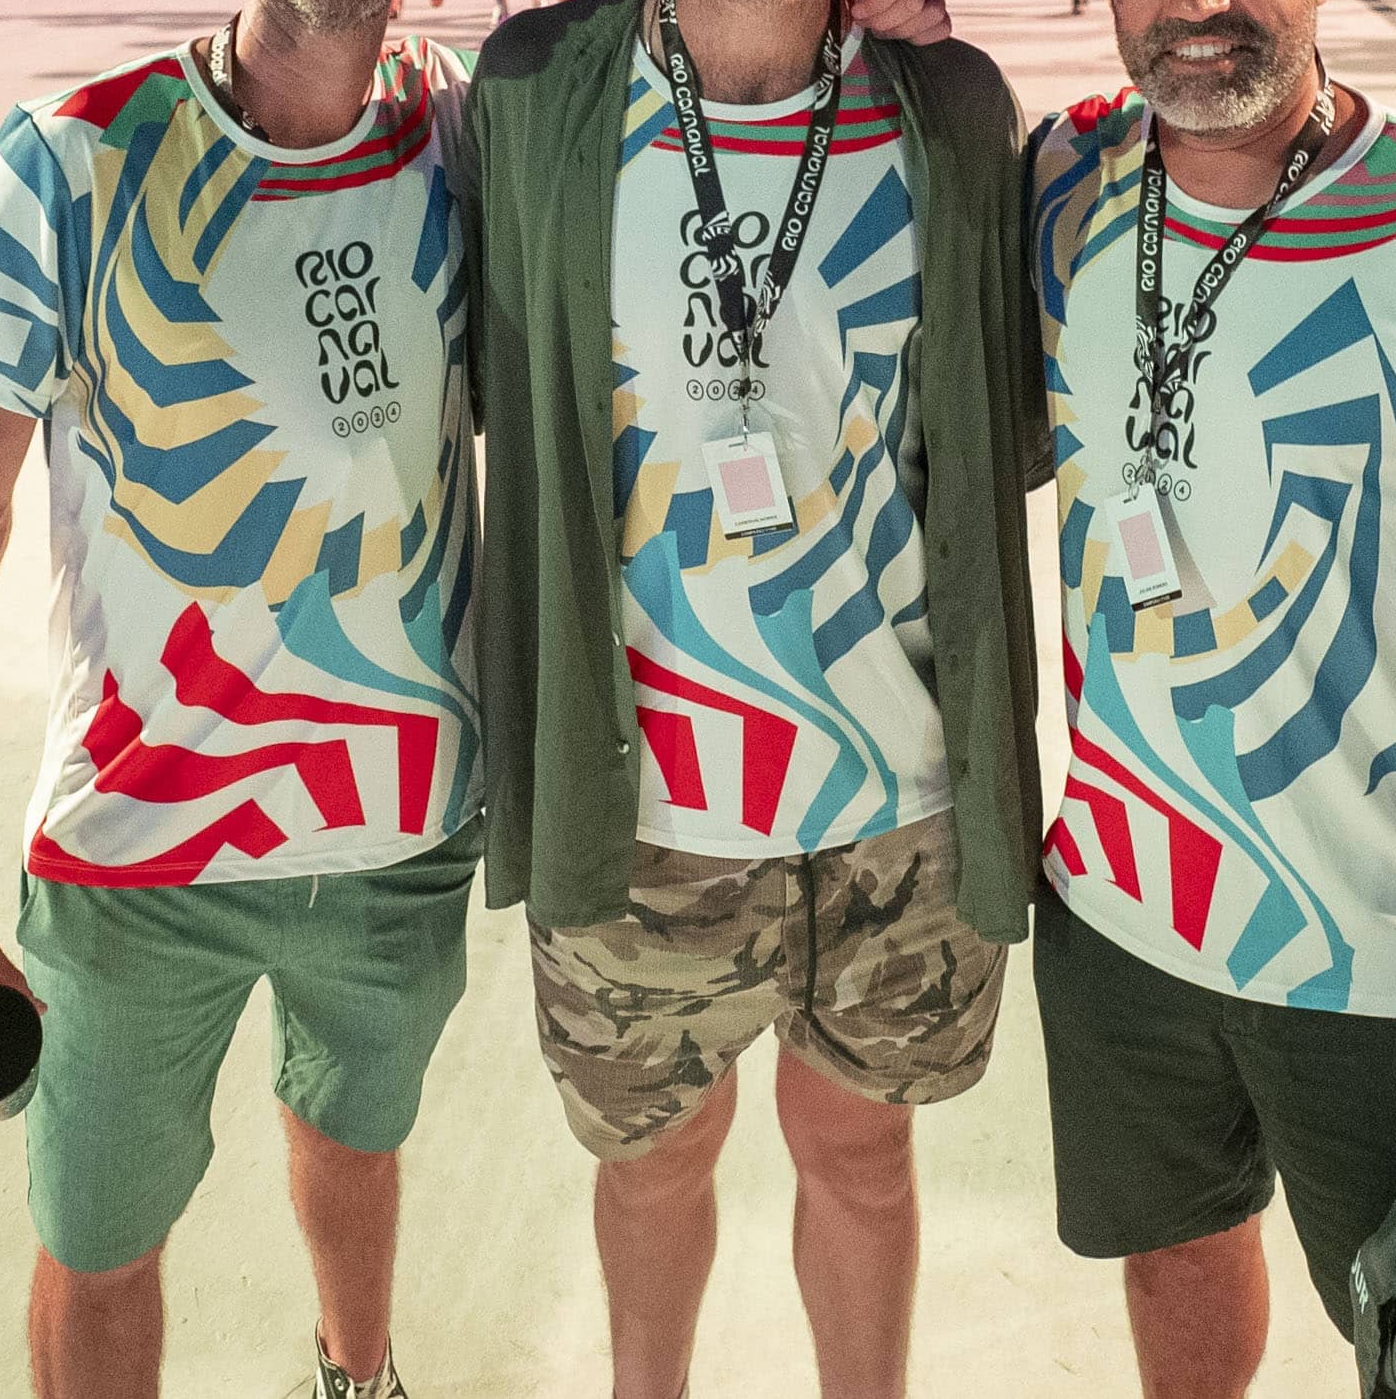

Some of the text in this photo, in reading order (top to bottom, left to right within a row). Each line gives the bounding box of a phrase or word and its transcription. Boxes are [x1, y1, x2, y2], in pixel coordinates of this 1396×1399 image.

[669, 53, 687, 84] RIO
[680, 209, 770, 249] RO
[781, 218, 802, 252] RIO
[295, 241, 374, 289] RIO
[1222, 233, 1247, 265] RIO
[1141, 259, 1157, 292] RIO
[1123, 465, 1190, 499] 224
